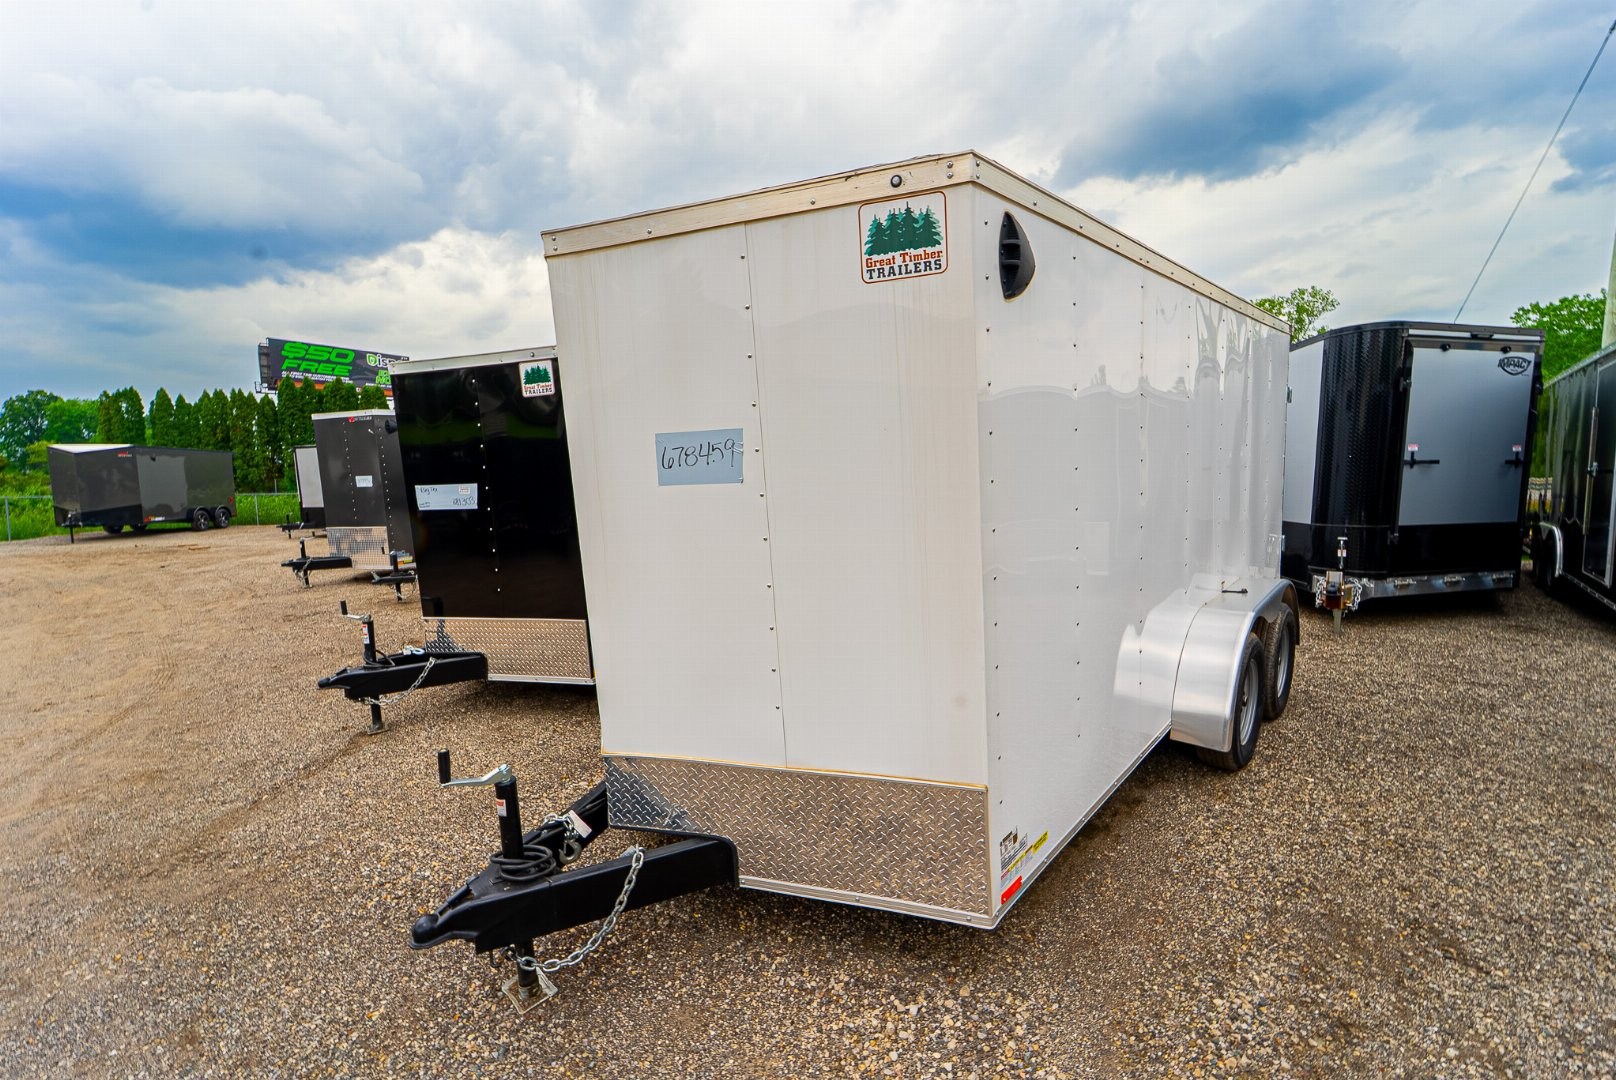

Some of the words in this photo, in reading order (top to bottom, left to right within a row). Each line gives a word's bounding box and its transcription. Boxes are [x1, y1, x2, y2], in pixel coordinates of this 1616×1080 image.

[865, 255, 896, 269] Great
[900, 249, 943, 263] Timber
[866, 259, 942, 280] TRAILERS
[281, 341, 355, 364] $50
[281, 359, 353, 376] FREE
[525, 387, 552, 395] TRAILERS
[661, 438, 735, 469] 678459
